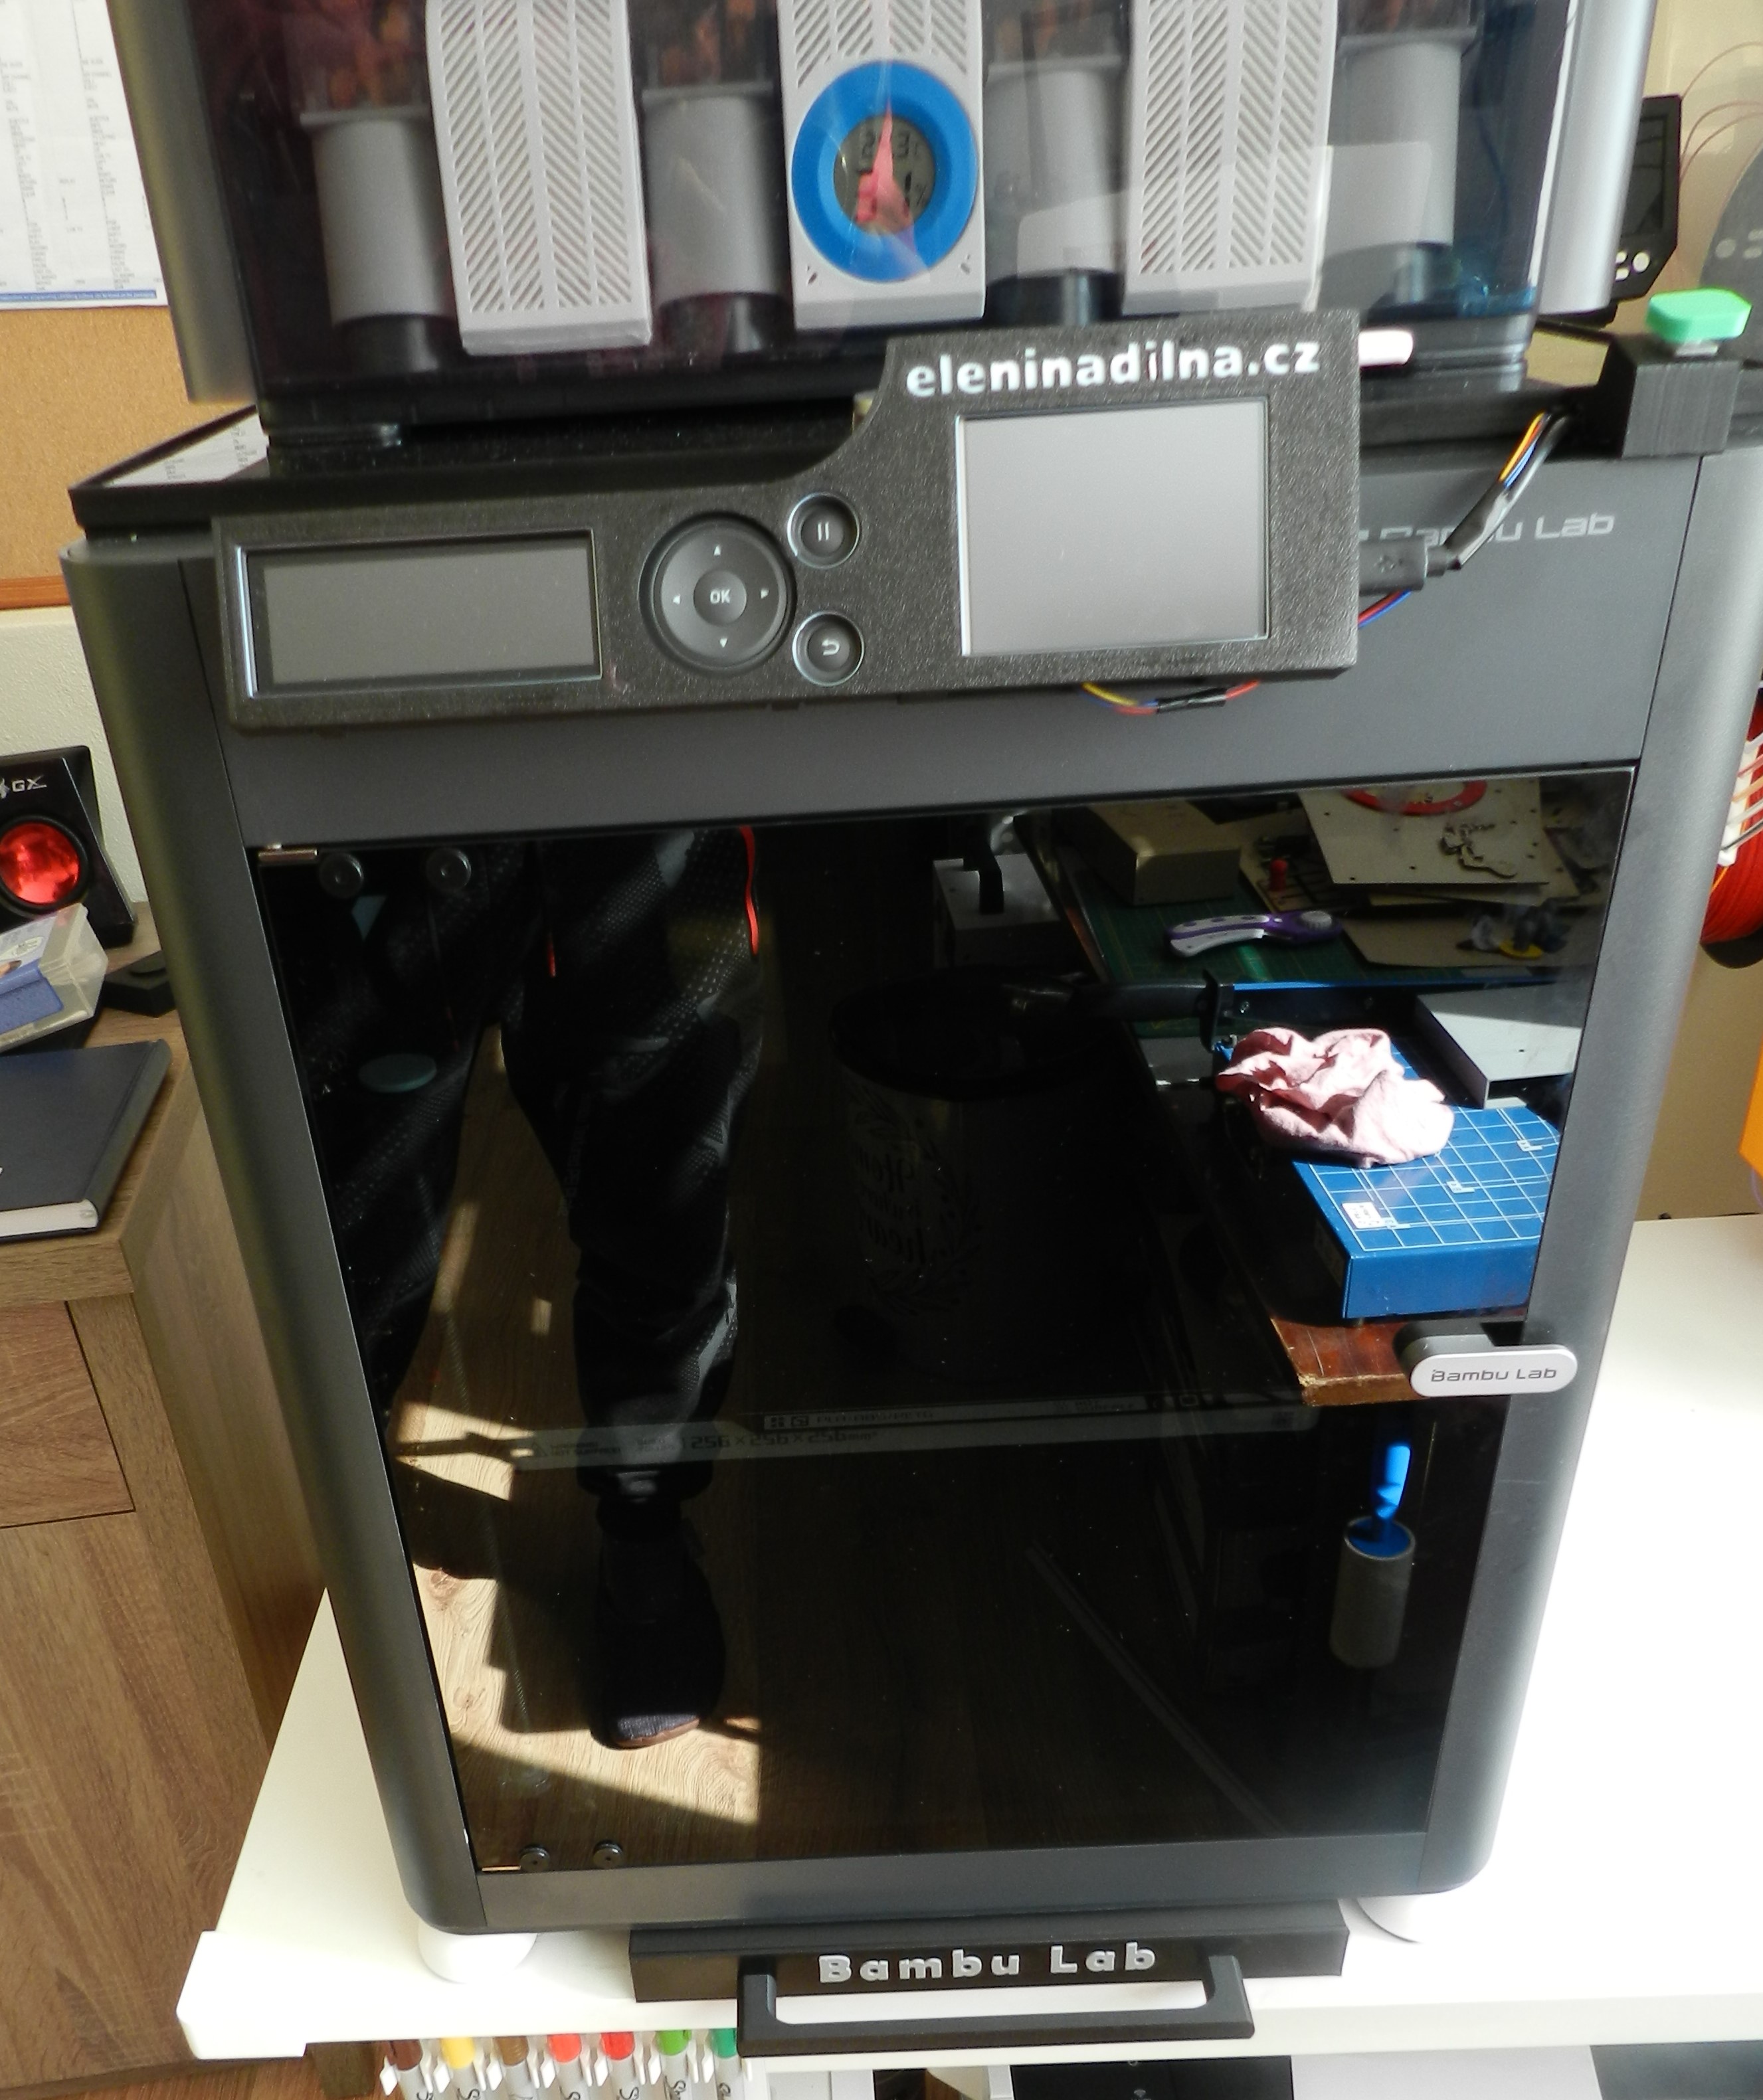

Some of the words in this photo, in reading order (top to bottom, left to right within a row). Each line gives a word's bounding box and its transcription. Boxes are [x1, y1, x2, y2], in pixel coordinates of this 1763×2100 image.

[906, 340, 1321, 397] eleninadilna.cz
[1534, 512, 1616, 540] Lab
[709, 589, 731, 604] OK
[12, 774, 47, 792] GX
[1431, 1369, 1509, 1382] Bambu
[1515, 1367, 1557, 1380] Lab
[818, 1949, 1020, 1984] Bambu
[1049, 1941, 1156, 1975] Lab
